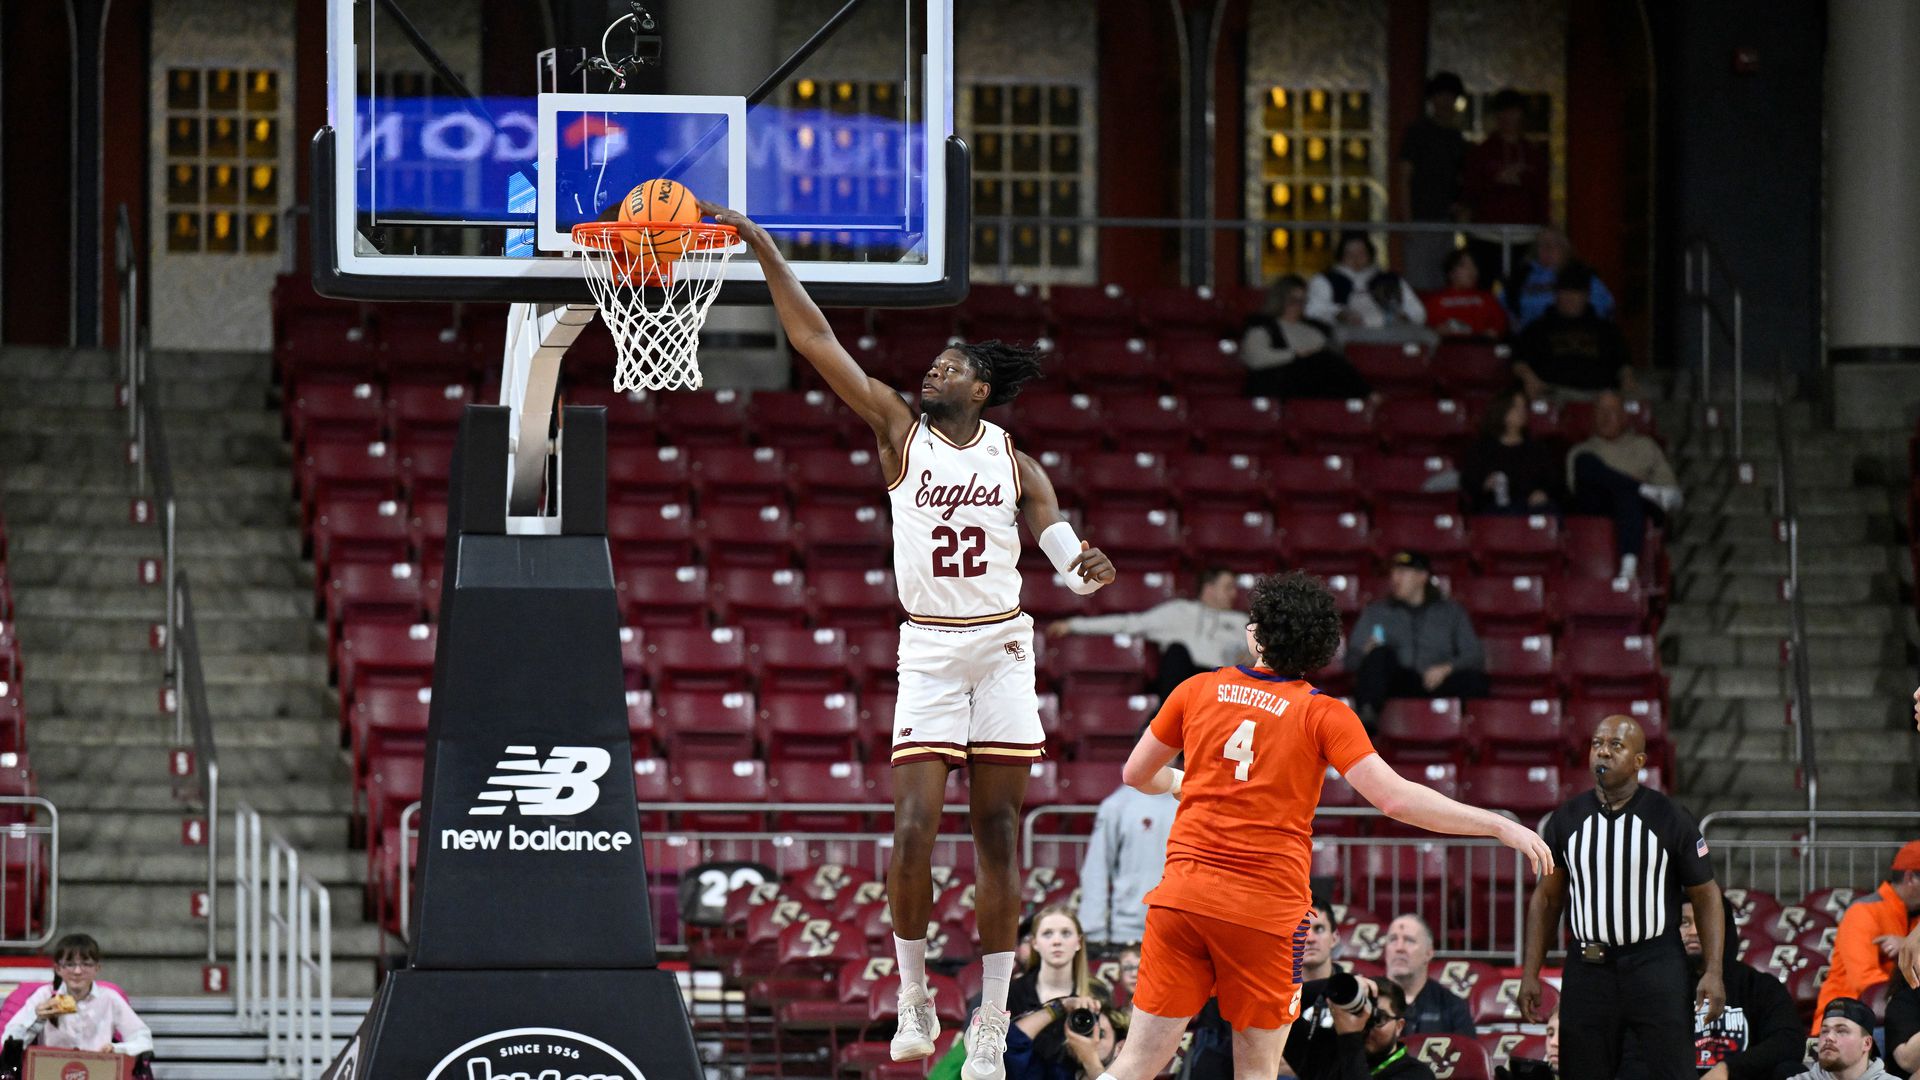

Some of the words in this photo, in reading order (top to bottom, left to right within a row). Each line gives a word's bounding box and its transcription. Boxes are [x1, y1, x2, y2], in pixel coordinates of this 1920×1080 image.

[915, 469, 1004, 521] Eagles
[931, 525, 988, 578] 22
[1217, 684, 1290, 717] SCHIEFFELIN
[1223, 719, 1257, 782] 4
[441, 828, 503, 850] new
[508, 824, 632, 852] balance
[500, 1044, 540, 1058] SINCE
[547, 1044, 580, 1060] 1956
